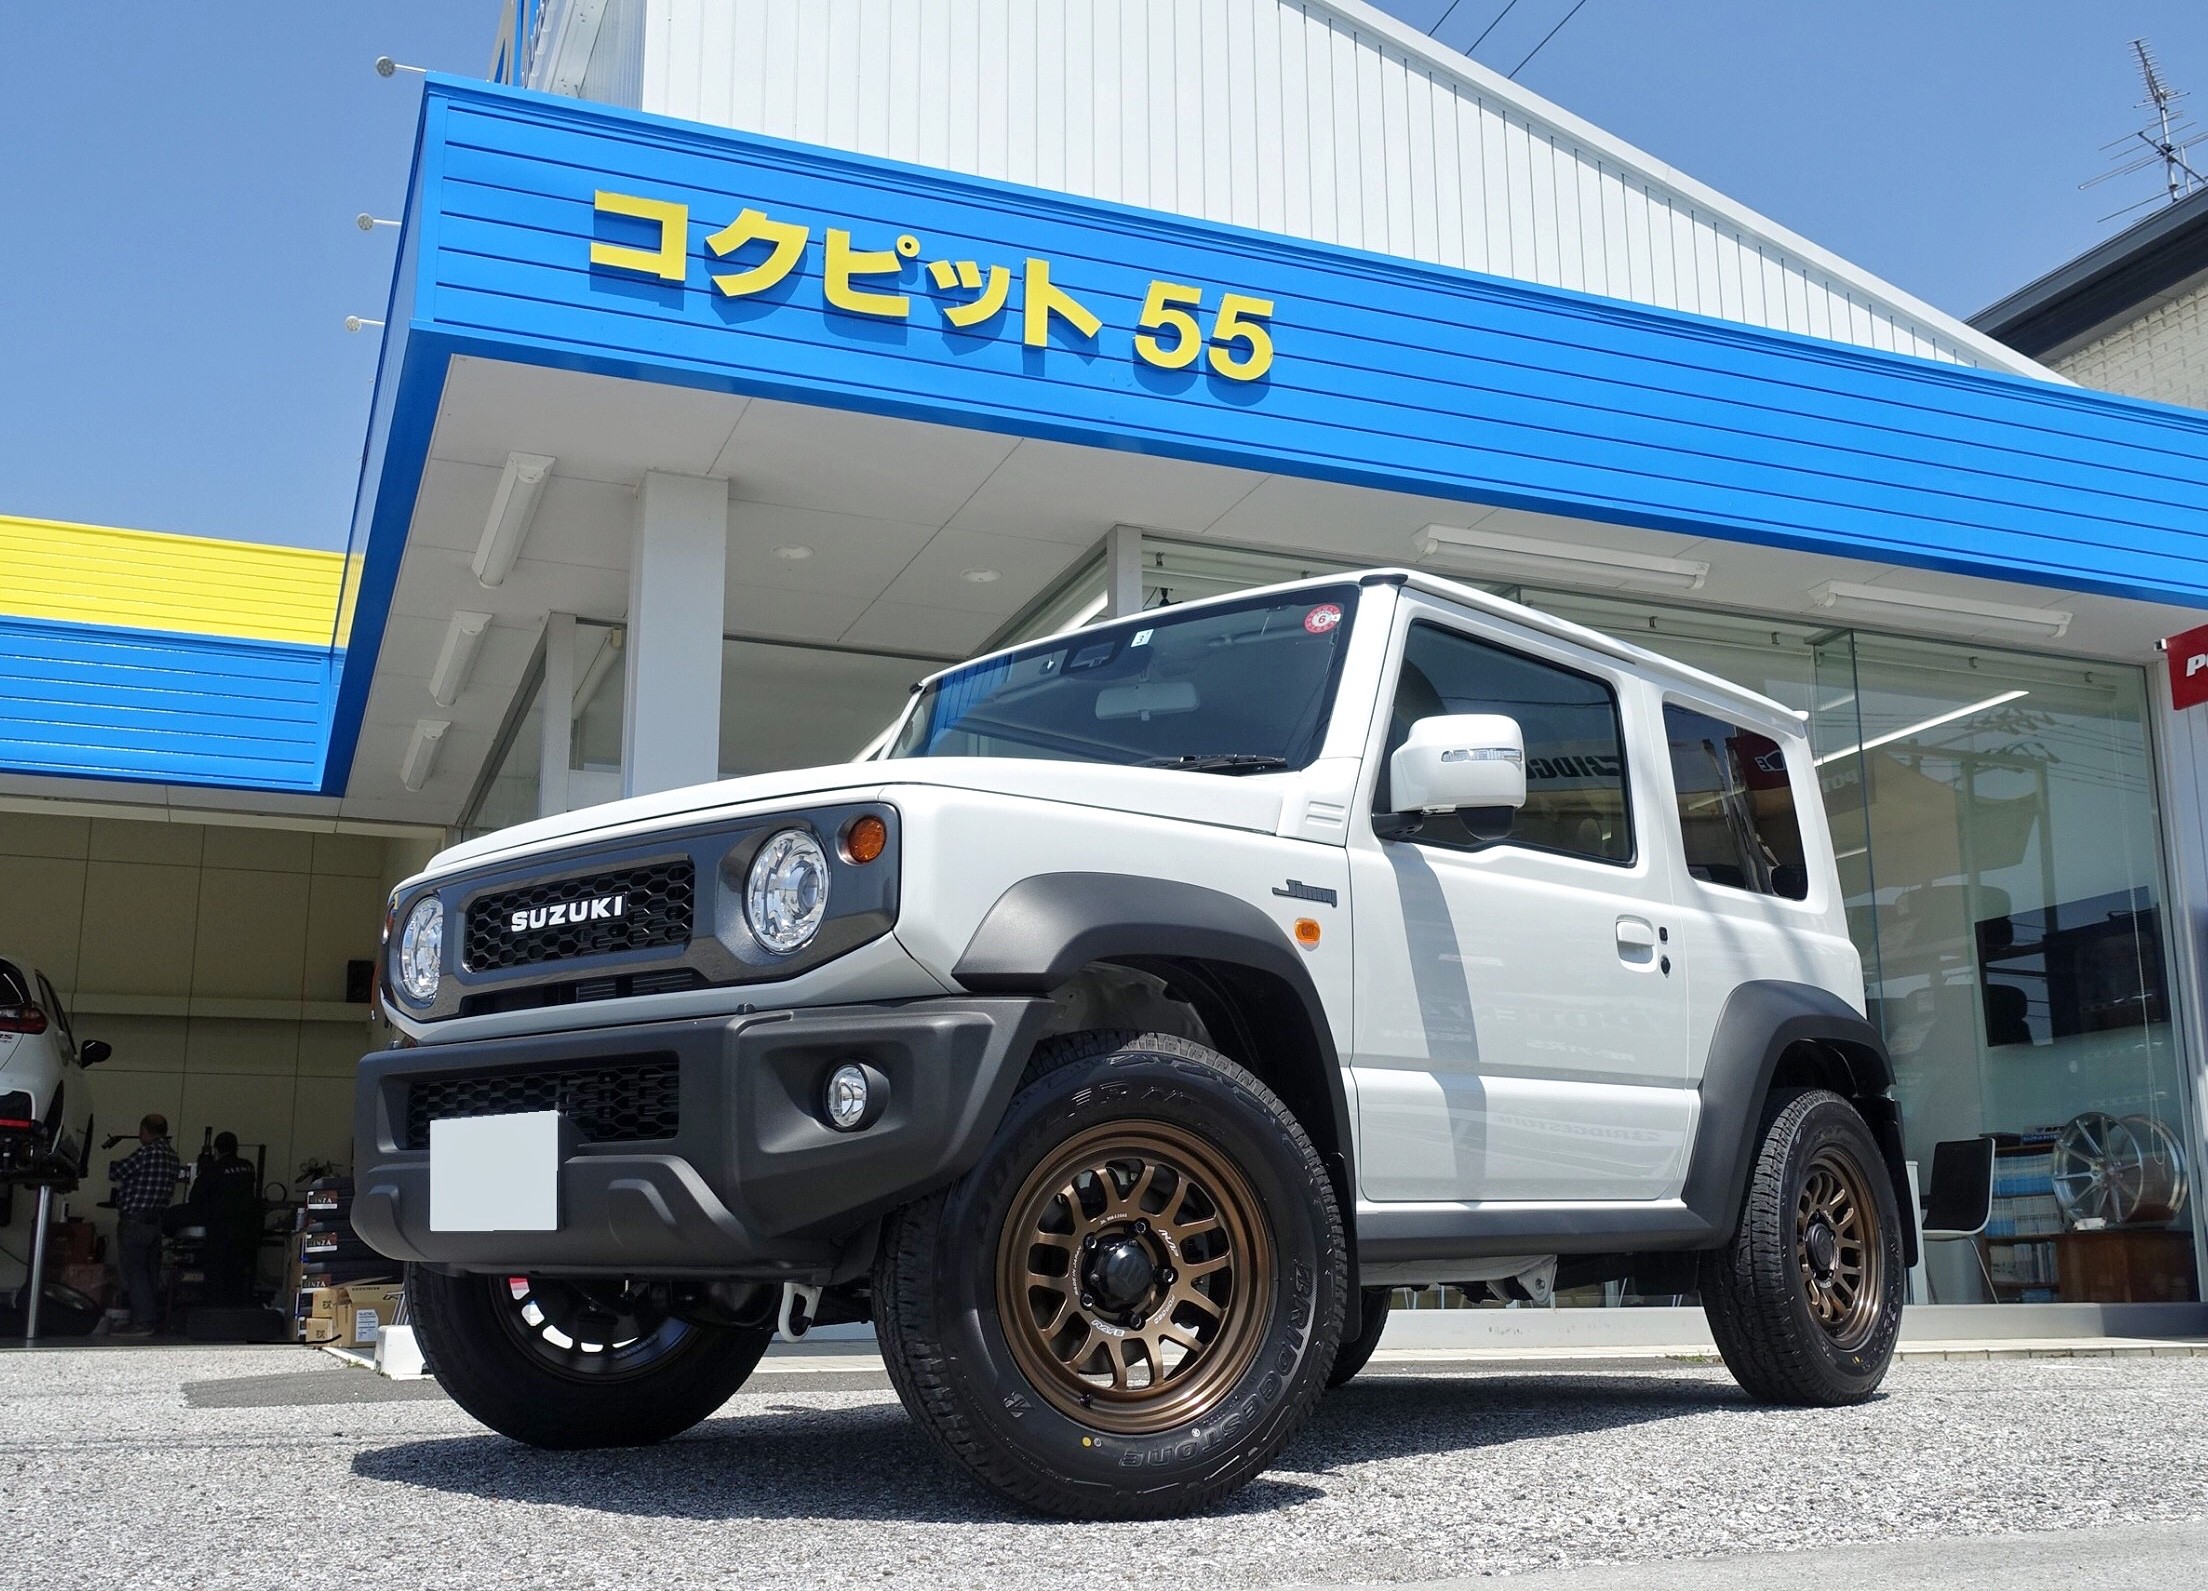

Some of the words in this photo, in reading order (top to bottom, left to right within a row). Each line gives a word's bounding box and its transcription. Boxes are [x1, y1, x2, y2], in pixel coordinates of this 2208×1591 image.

[590, 189, 1103, 348] コクピット
[1132, 279, 1275, 382] 55
[511, 895, 623, 933] SUZUKI
[1272, 878, 1337, 909] Jimny
[1119, 1258, 1315, 1469] BRIDGESTONE
